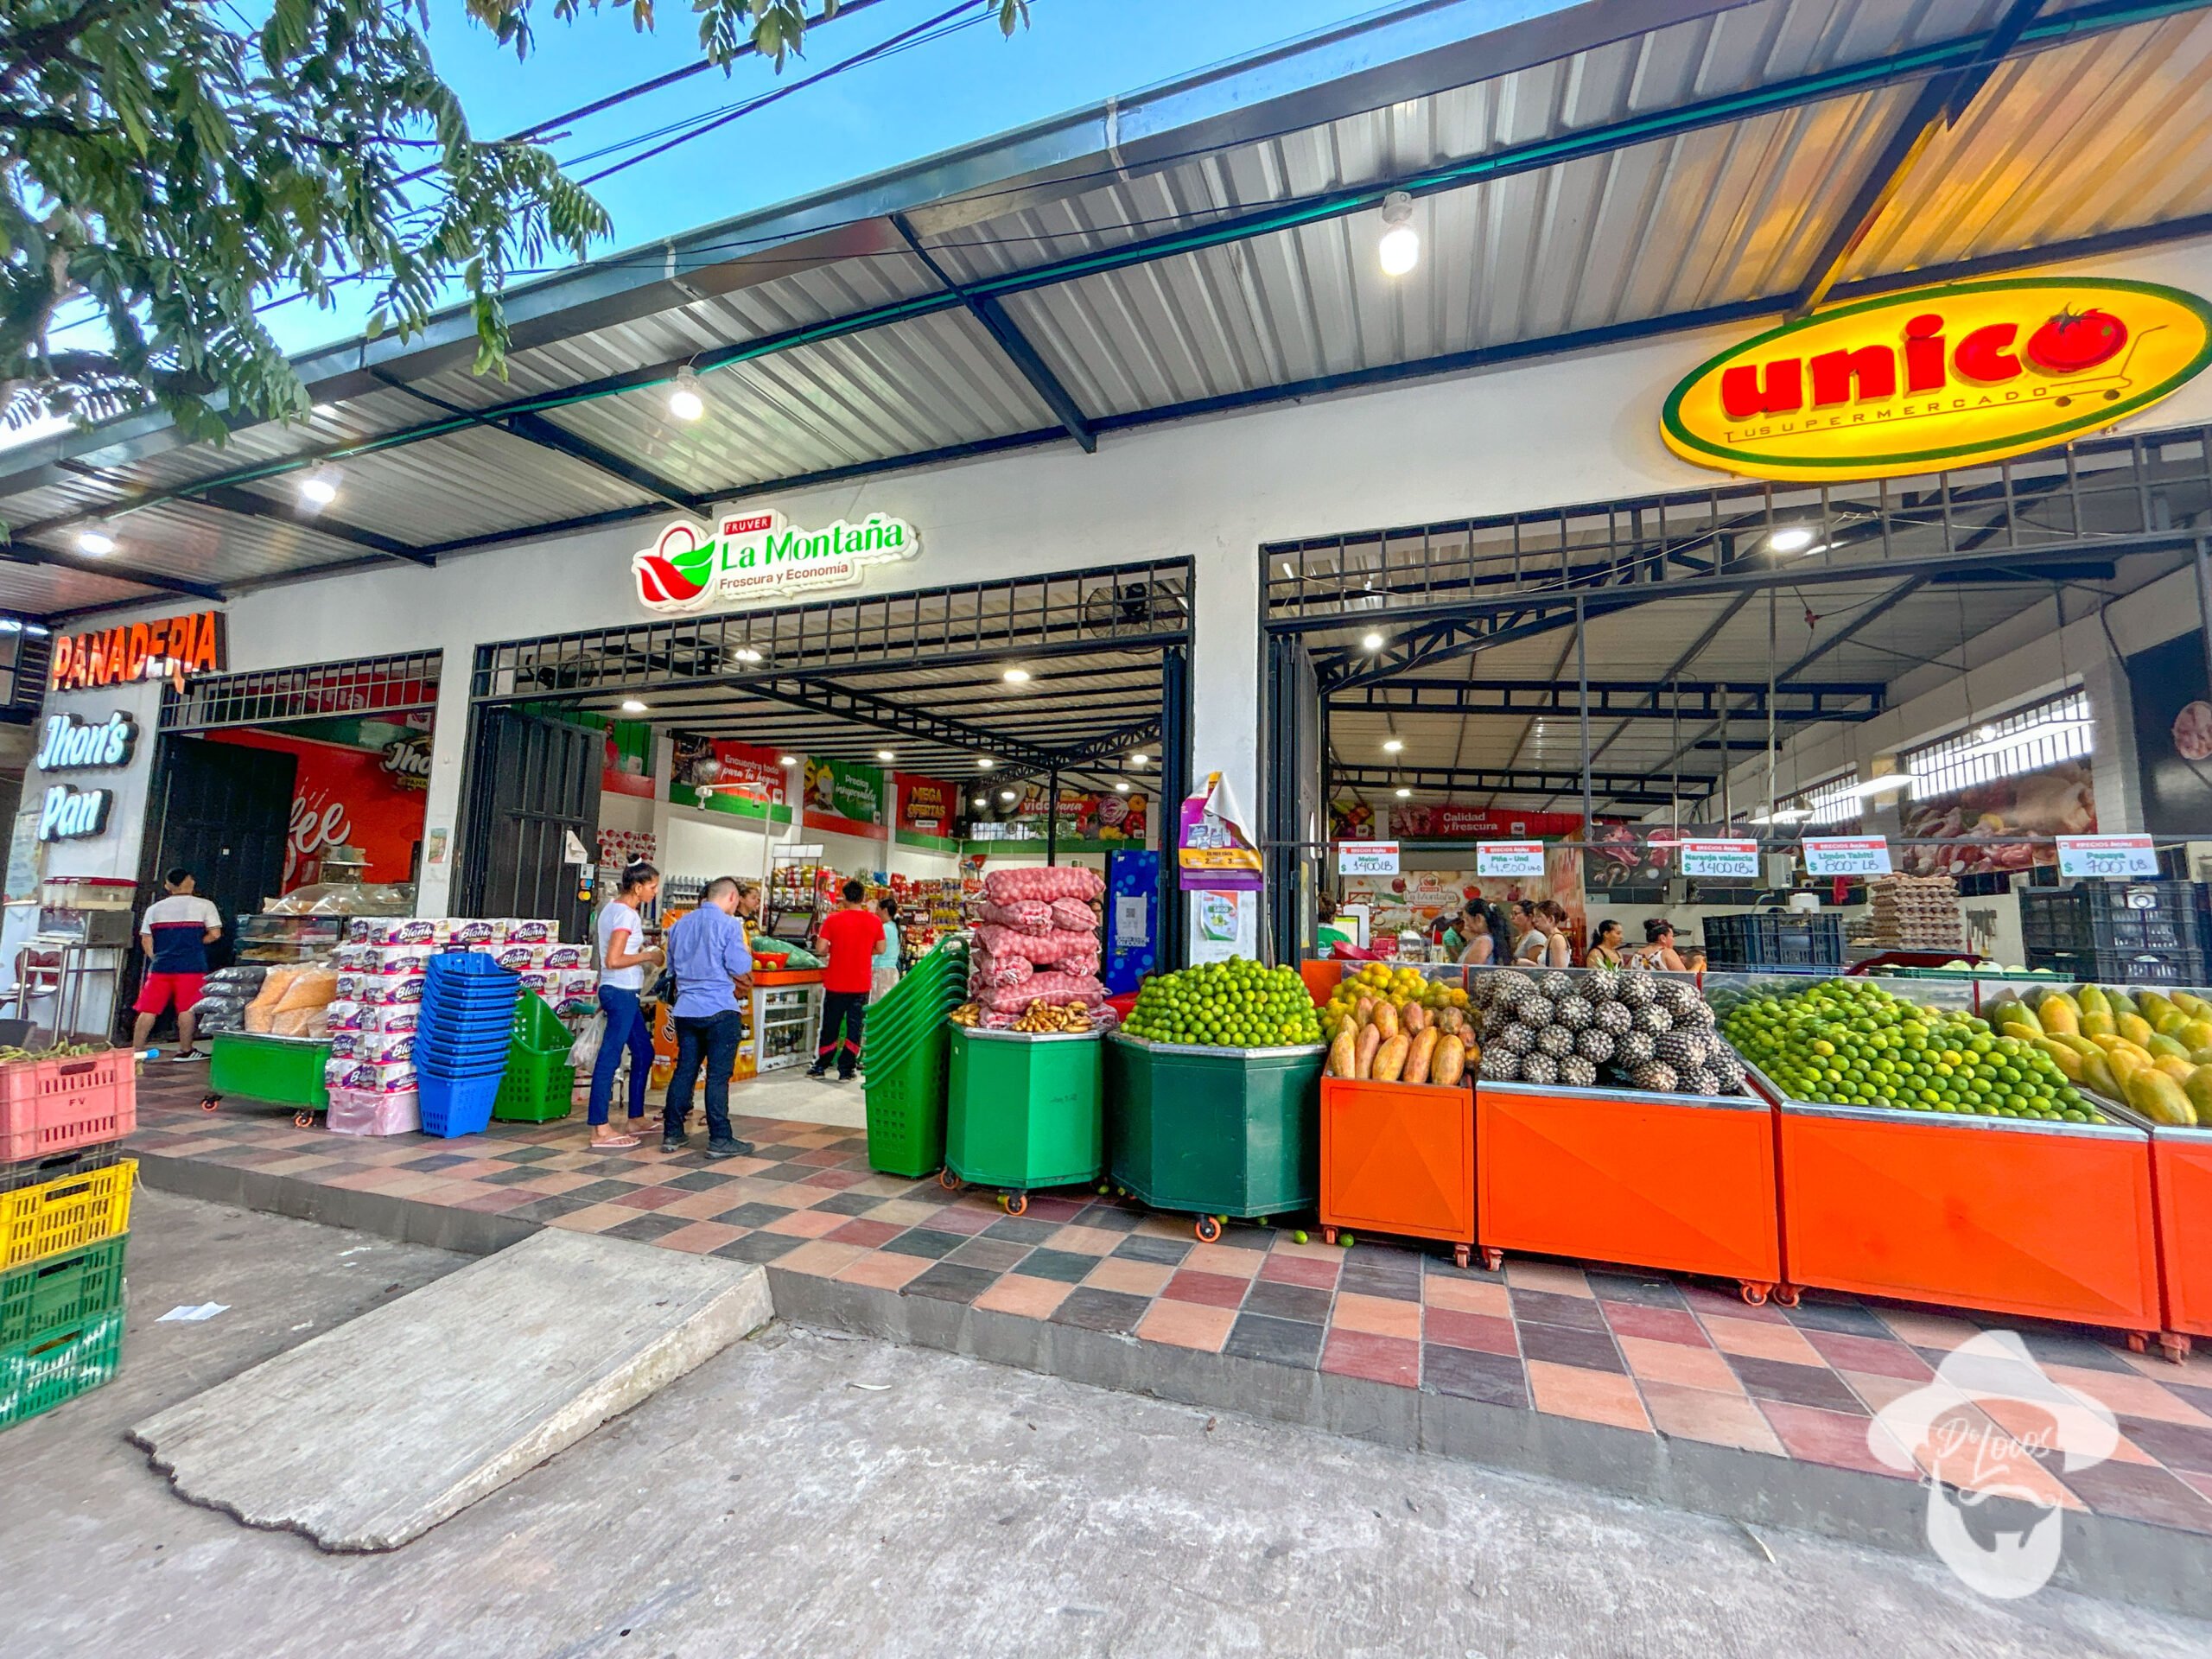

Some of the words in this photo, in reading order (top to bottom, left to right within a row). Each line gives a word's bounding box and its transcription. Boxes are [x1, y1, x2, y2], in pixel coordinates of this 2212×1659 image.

[724, 518, 770, 534] FRUVER
[721, 542, 755, 571] La
[766, 519, 905, 566] Montaña
[720, 574, 774, 589] Frescura
[776, 573, 785, 584] y
[785, 562, 849, 581] Economía
[52, 610, 218, 693] PANADERIA
[37, 712, 130, 771] Jhon's
[39, 785, 104, 841] Pan
[1443, 812, 1486, 822] Calidad
[1443, 823, 1450, 834] y
[1452, 822, 1498, 830] frescura
[1685, 854, 1717, 862] Naranja
[2087, 852, 2126, 861] Papaya
[1479, 864, 1486, 874] $
[1684, 862, 1691, 872] $
[1809, 861, 1817, 872] $
[2063, 861, 2074, 873] $
